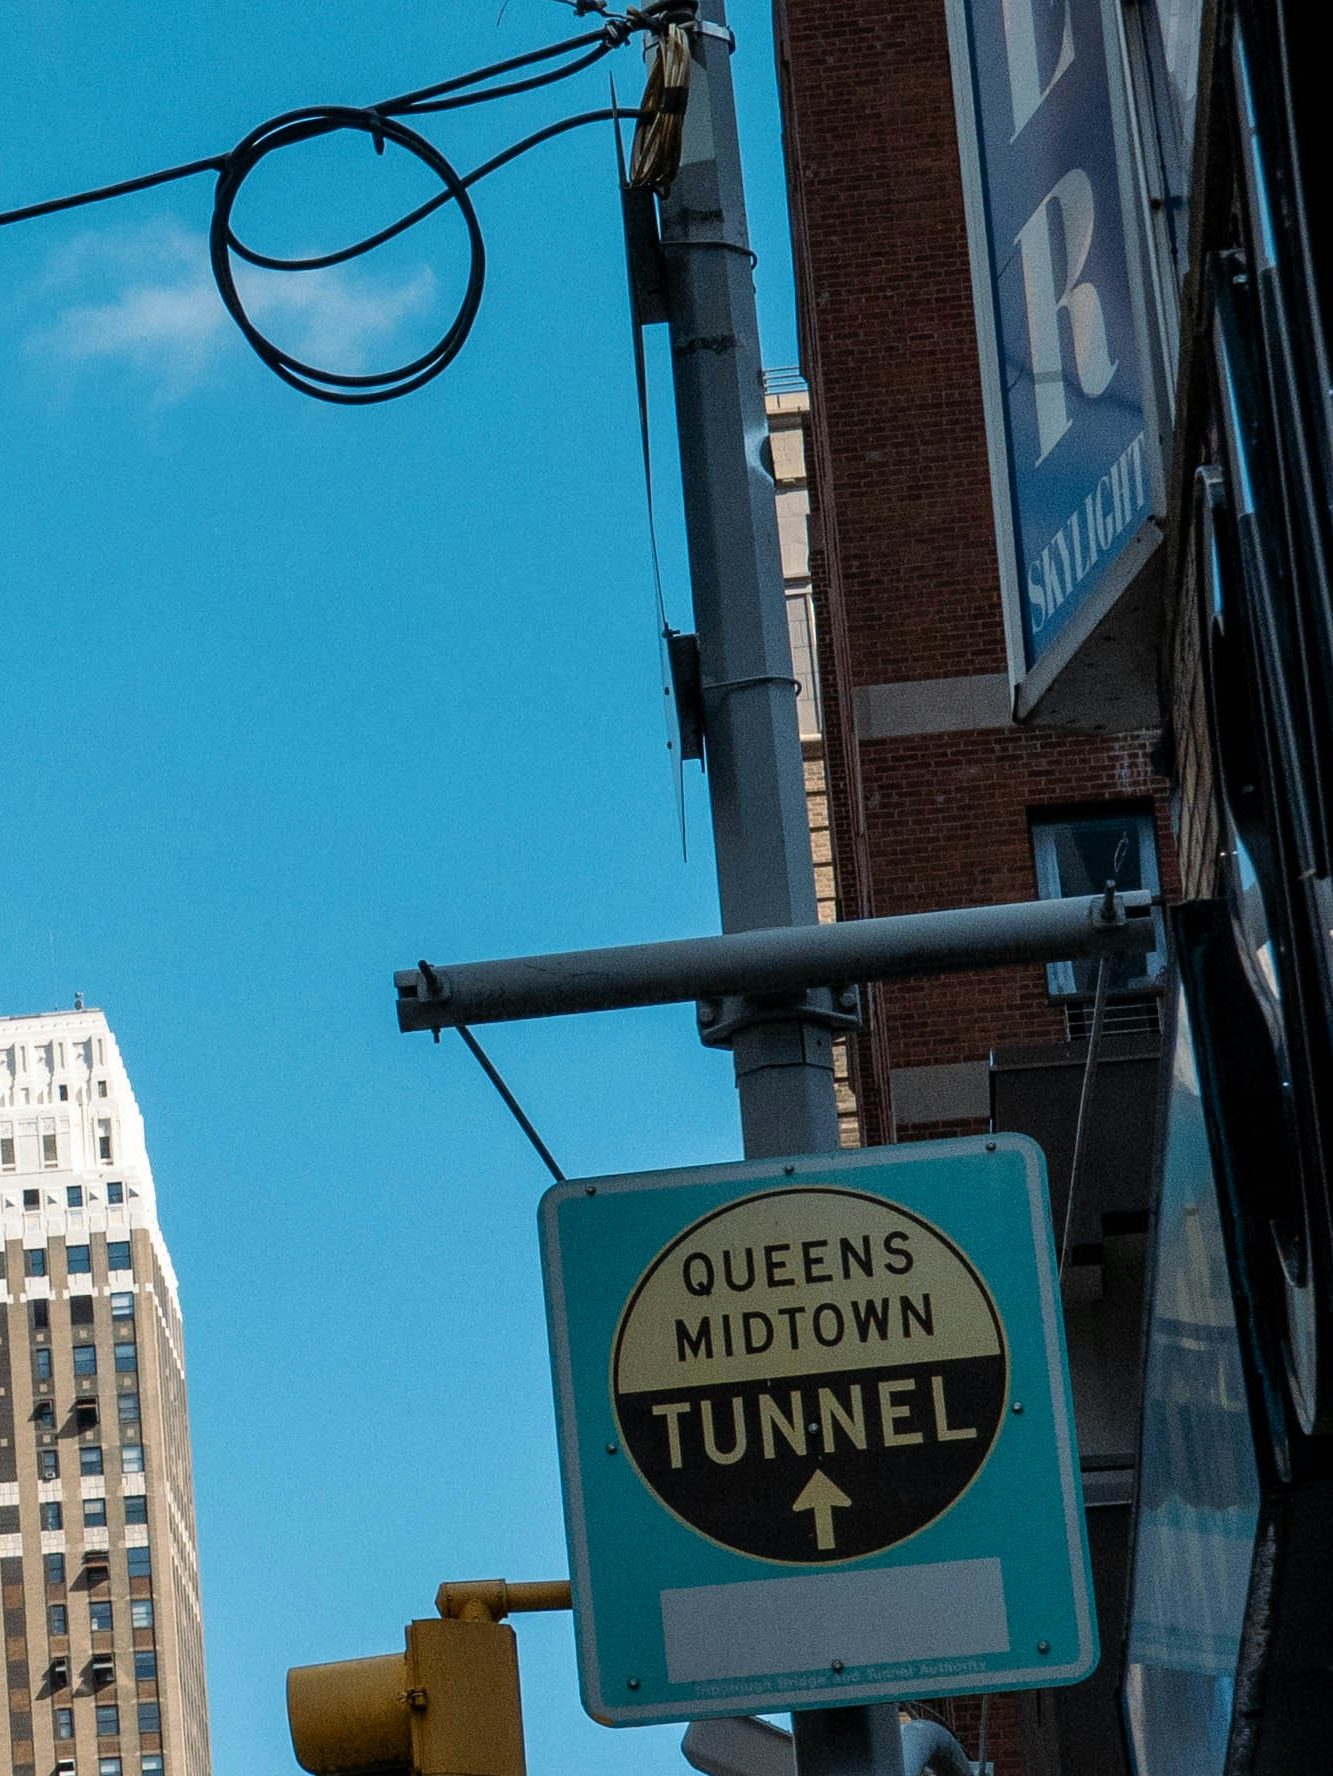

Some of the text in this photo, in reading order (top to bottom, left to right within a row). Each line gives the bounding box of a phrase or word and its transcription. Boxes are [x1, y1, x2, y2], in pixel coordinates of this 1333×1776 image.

[1028, 431, 1148, 636] SKYLIGHT
[681, 1229, 915, 1297] QUEENS
[674, 1293, 935, 1362] MIDTOWN
[651, 1374, 978, 1470] TUNNEL
[779, 1676, 826, 1693] Bridge
[867, 1666, 914, 1680] Tunnel
[919, 1660, 987, 1677] Authority
